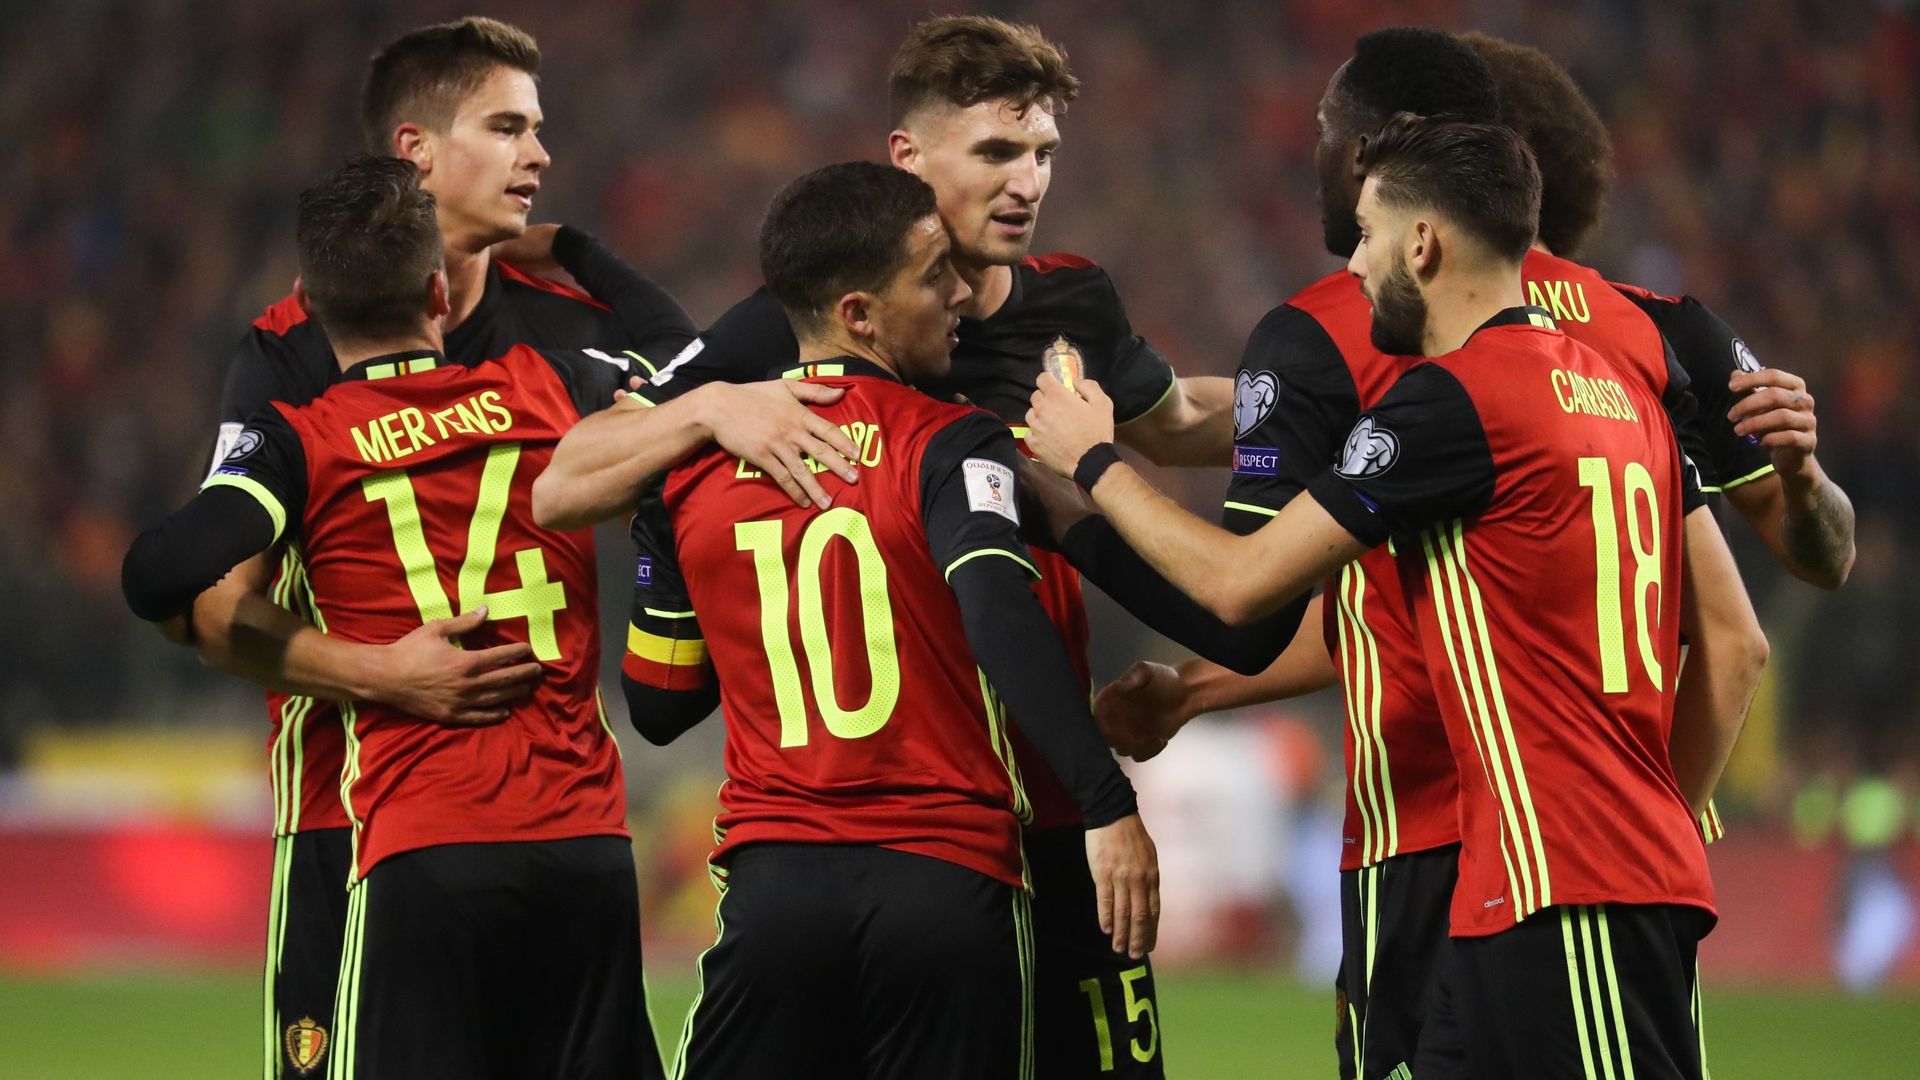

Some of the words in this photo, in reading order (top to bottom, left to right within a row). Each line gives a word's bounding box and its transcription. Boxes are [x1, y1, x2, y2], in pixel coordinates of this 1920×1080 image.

[1240, 454, 1278, 468] RESPECT
[1551, 369, 1638, 423] CARRASCO
[361, 442, 567, 661] 14
[734, 507, 900, 748] 10
[1577, 457, 1662, 692] 18
[1079, 965, 1158, 1071] 15
